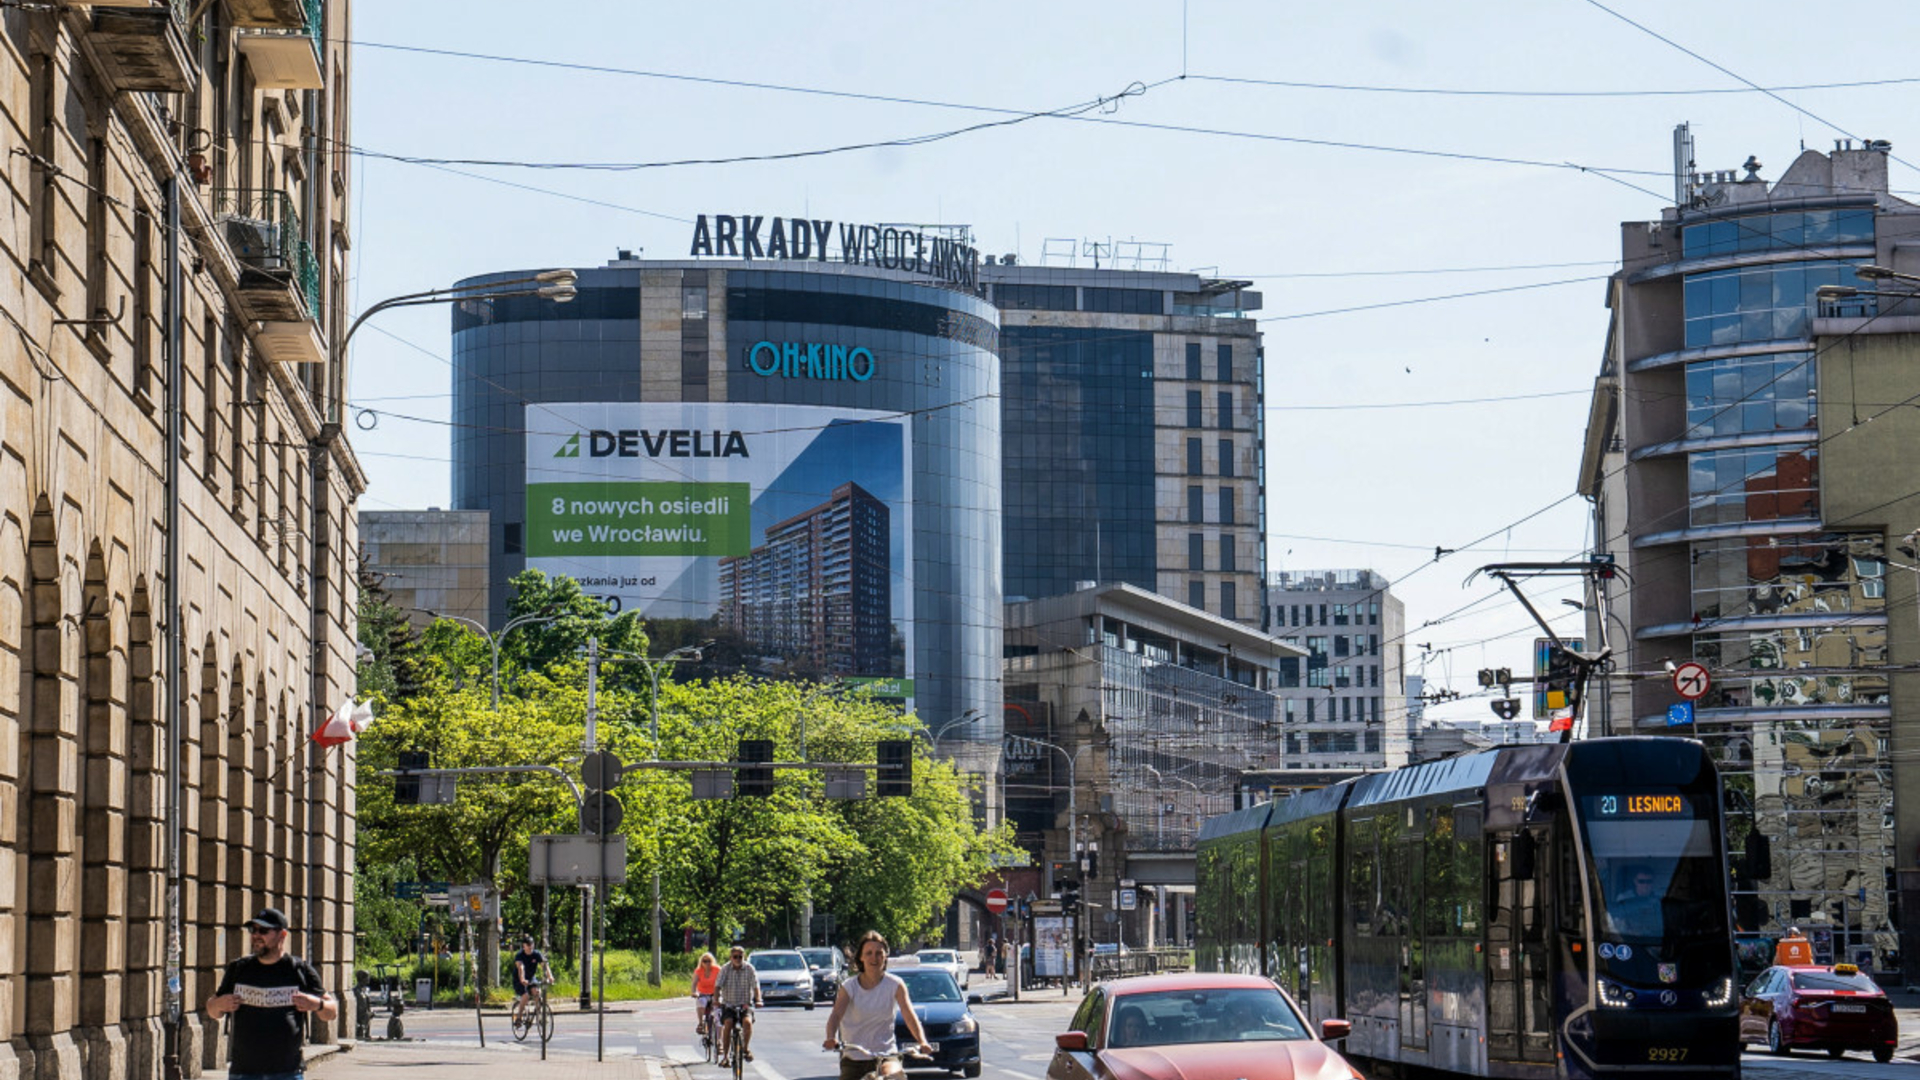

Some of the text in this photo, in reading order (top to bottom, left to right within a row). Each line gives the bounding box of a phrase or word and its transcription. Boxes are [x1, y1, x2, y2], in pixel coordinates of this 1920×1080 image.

[690, 214, 832, 262] ARKADY
[590, 429, 749, 458] DEVELIA
[552, 496, 729, 518] 8 nowych osiedli
[552, 523, 707, 542] we Wrocławiu.
[640, 575, 656, 586] od
[1628, 796, 1682, 813] LESNICA
[1649, 1048, 1688, 1060] 2927
